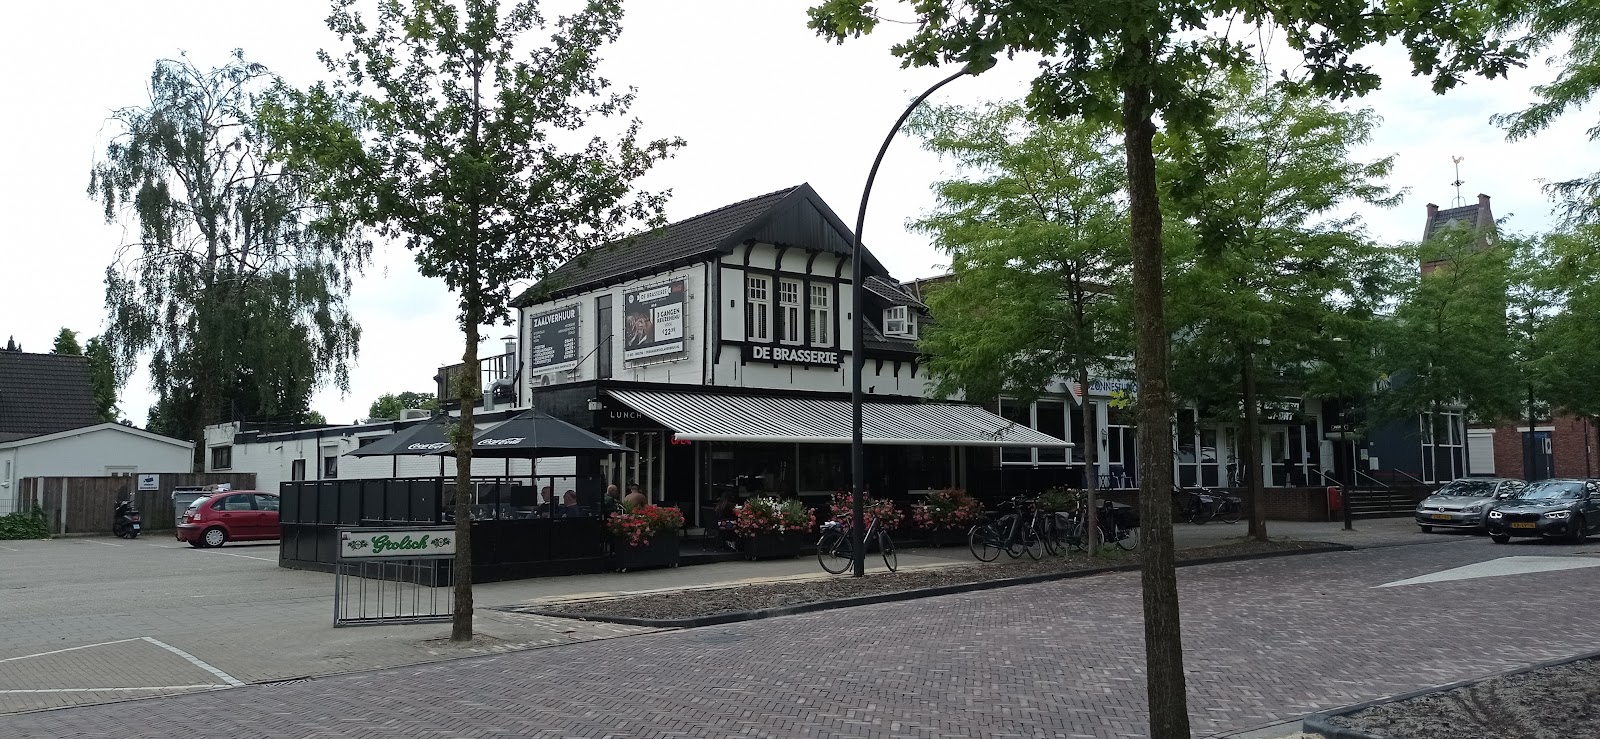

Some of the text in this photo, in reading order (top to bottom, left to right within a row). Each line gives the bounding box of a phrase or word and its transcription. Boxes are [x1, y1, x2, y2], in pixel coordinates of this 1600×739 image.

[533, 309, 576, 328] ZAALVERHUUR
[753, 346, 838, 364] DE BRASSERIE
[610, 411, 642, 419] LUNCH
[371, 534, 430, 554] Grolsch
